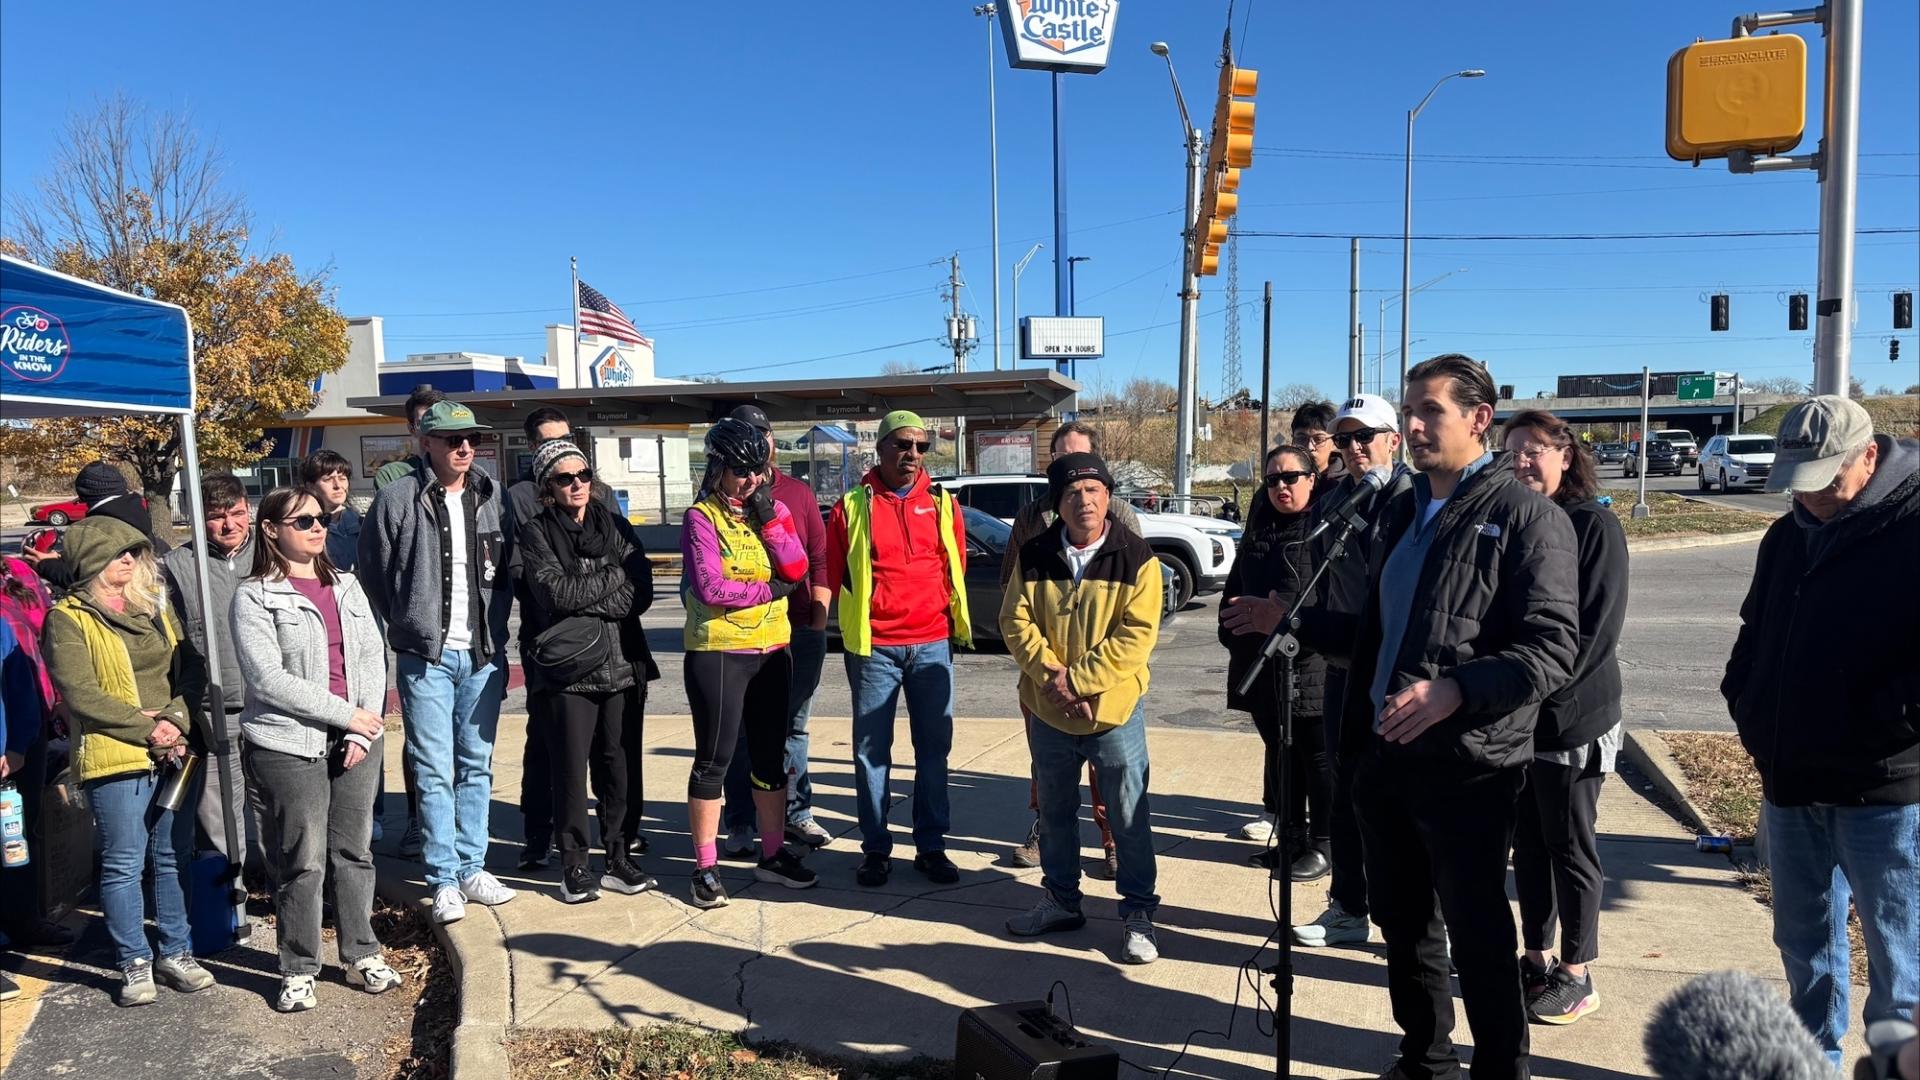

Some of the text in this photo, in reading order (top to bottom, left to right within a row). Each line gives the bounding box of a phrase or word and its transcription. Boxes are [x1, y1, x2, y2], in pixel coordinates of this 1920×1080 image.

[1023, 15, 1102, 42] Castle
[1709, 48, 1787, 63] ECONOLITE
[1, 324, 67, 356] Riders
[1044, 345, 1096, 353] OPEN 24 HOURS
[13, 361, 52, 372] KNOW
[30, 355, 46, 363] THE
[604, 366, 628, 383] White
